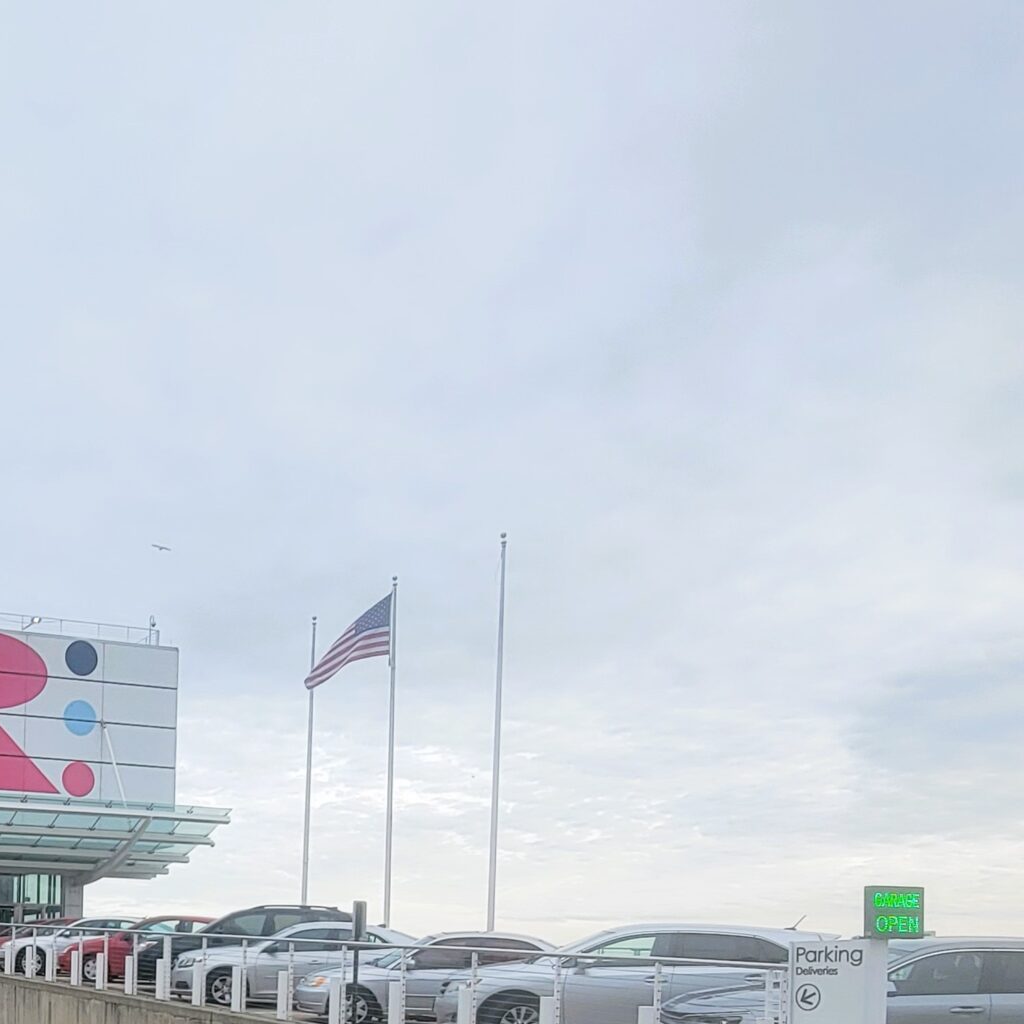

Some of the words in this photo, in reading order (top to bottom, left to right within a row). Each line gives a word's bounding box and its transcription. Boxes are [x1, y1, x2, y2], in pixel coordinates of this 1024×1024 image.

[874, 892, 920, 908] GARAGE
[876, 916, 919, 933] OPEN
[796, 945, 863, 966] Parking
[796, 966, 838, 976] Deliveries
